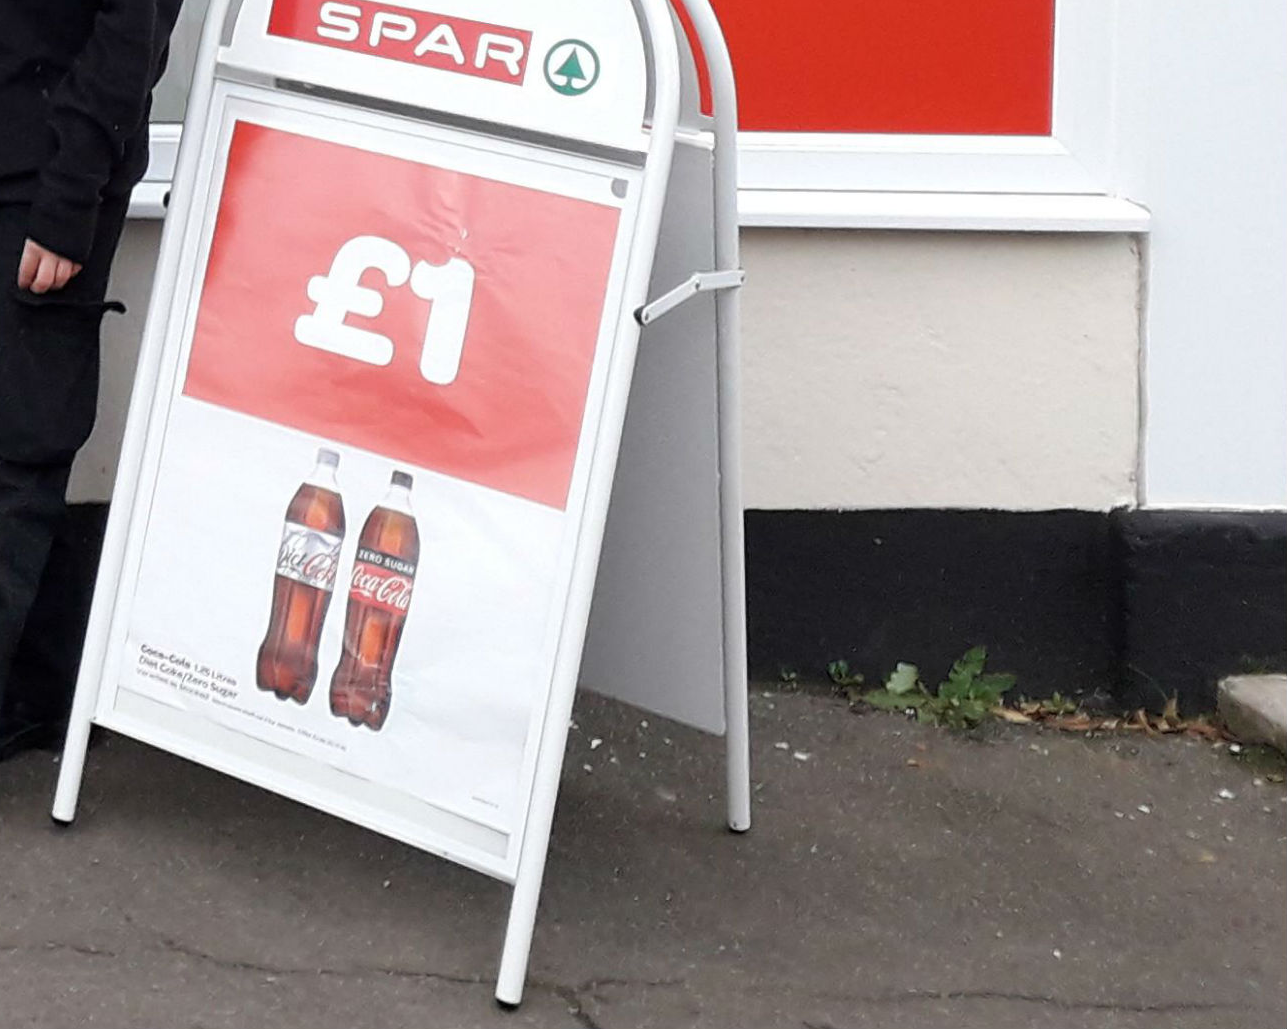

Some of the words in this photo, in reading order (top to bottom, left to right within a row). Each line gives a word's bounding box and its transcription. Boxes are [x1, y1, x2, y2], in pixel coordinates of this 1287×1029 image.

[317, 1, 525, 76] SPAR
[293, 234, 476, 386] £1
[358, 549, 383, 564] ZERO
[384, 556, 415, 574] SUGAR
